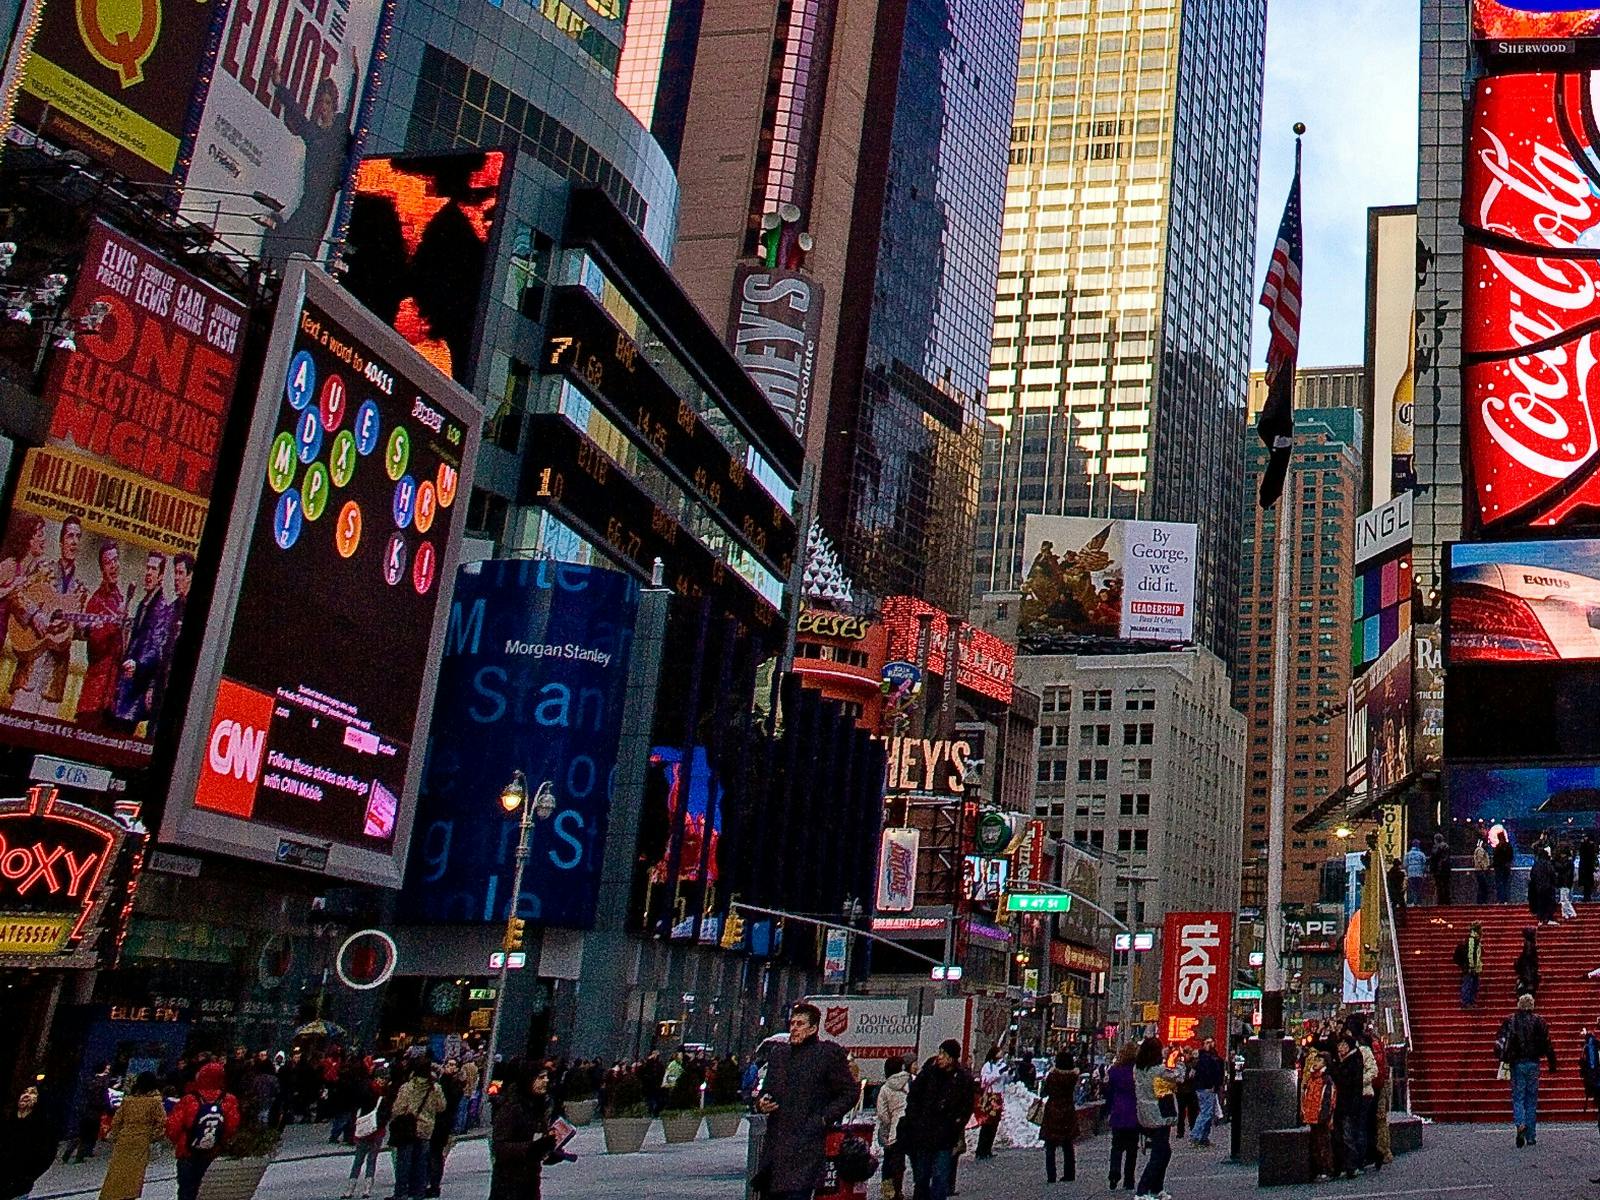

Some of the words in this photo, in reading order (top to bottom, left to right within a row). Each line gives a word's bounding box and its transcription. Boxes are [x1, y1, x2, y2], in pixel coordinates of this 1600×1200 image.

[75, 0, 163, 89] Q
[1498, 41, 1567, 54] SHERWOOD
[102, 240, 138, 279] ELVIS
[96, 265, 133, 297] PRESLEY
[161, 273, 176, 293] LEE
[135, 278, 171, 317] LEWIS
[176, 285, 207, 321] CARL
[1481, 127, 1600, 480] Coca-Cola
[173, 311, 203, 336] PERKINS
[211, 304, 241, 330] JOHNNY
[207, 320, 239, 354] CASH
[82, 295, 233, 416] ONE
[301, 310, 321, 340] Text
[329, 337, 353, 363] word
[352, 352, 363, 372] to
[364, 361, 393, 395] 40411
[294, 360, 307, 392] A
[794, 340, 814, 438] Chocolate
[61, 352, 219, 455] ELECTRIFYING
[329, 382, 342, 413] U
[303, 413, 316, 444] D
[362, 409, 374, 438] E
[51, 395, 211, 492] NIGHT
[275, 441, 291, 475] M
[337, 438, 350, 469] X
[393, 436, 404, 463] S
[310, 471, 322, 499] P
[400, 483, 411, 512] H
[285, 497, 298, 529] Y
[421, 489, 432, 516] R
[25, 491, 86, 518] INSPIRED
[87, 509, 105, 524] BY
[106, 515, 130, 532] THE
[131, 524, 162, 542] TRUE
[162, 533, 199, 550] STORY
[344, 510, 357, 538] S
[1152, 529, 1170, 546] By
[391, 538, 403, 569] K
[1132, 544, 1188, 563] George,
[1149, 563, 1169, 574] we
[1138, 577, 1162, 592] did
[1165, 578, 1178, 592] it.
[1523, 574, 1571, 588] EQUUS
[797, 603, 870, 640] eese's
[1132, 602, 1181, 616] LEADERSHIP
[1139, 615, 1152, 623] Pass
[505, 639, 562, 659] Morgan
[564, 642, 612, 667] Stanley
[209, 719, 266, 784] CNN
[66, 768, 88, 784] CBS
[267, 750, 293, 772] Follow
[293, 754, 313, 778] these
[313, 763, 337, 785] stories
[264, 772, 281, 791] with
[281, 776, 300, 796] CNN
[300, 781, 324, 802] Mobile
[1031, 899, 1044, 908] 47
[1178, 920, 1220, 1006] tkts
[110, 1006, 150, 1021] BLUE
[155, 1008, 180, 1022] FIN
[860, 1014, 899, 1025] DOING
[855, 1025, 886, 1034] MOST
